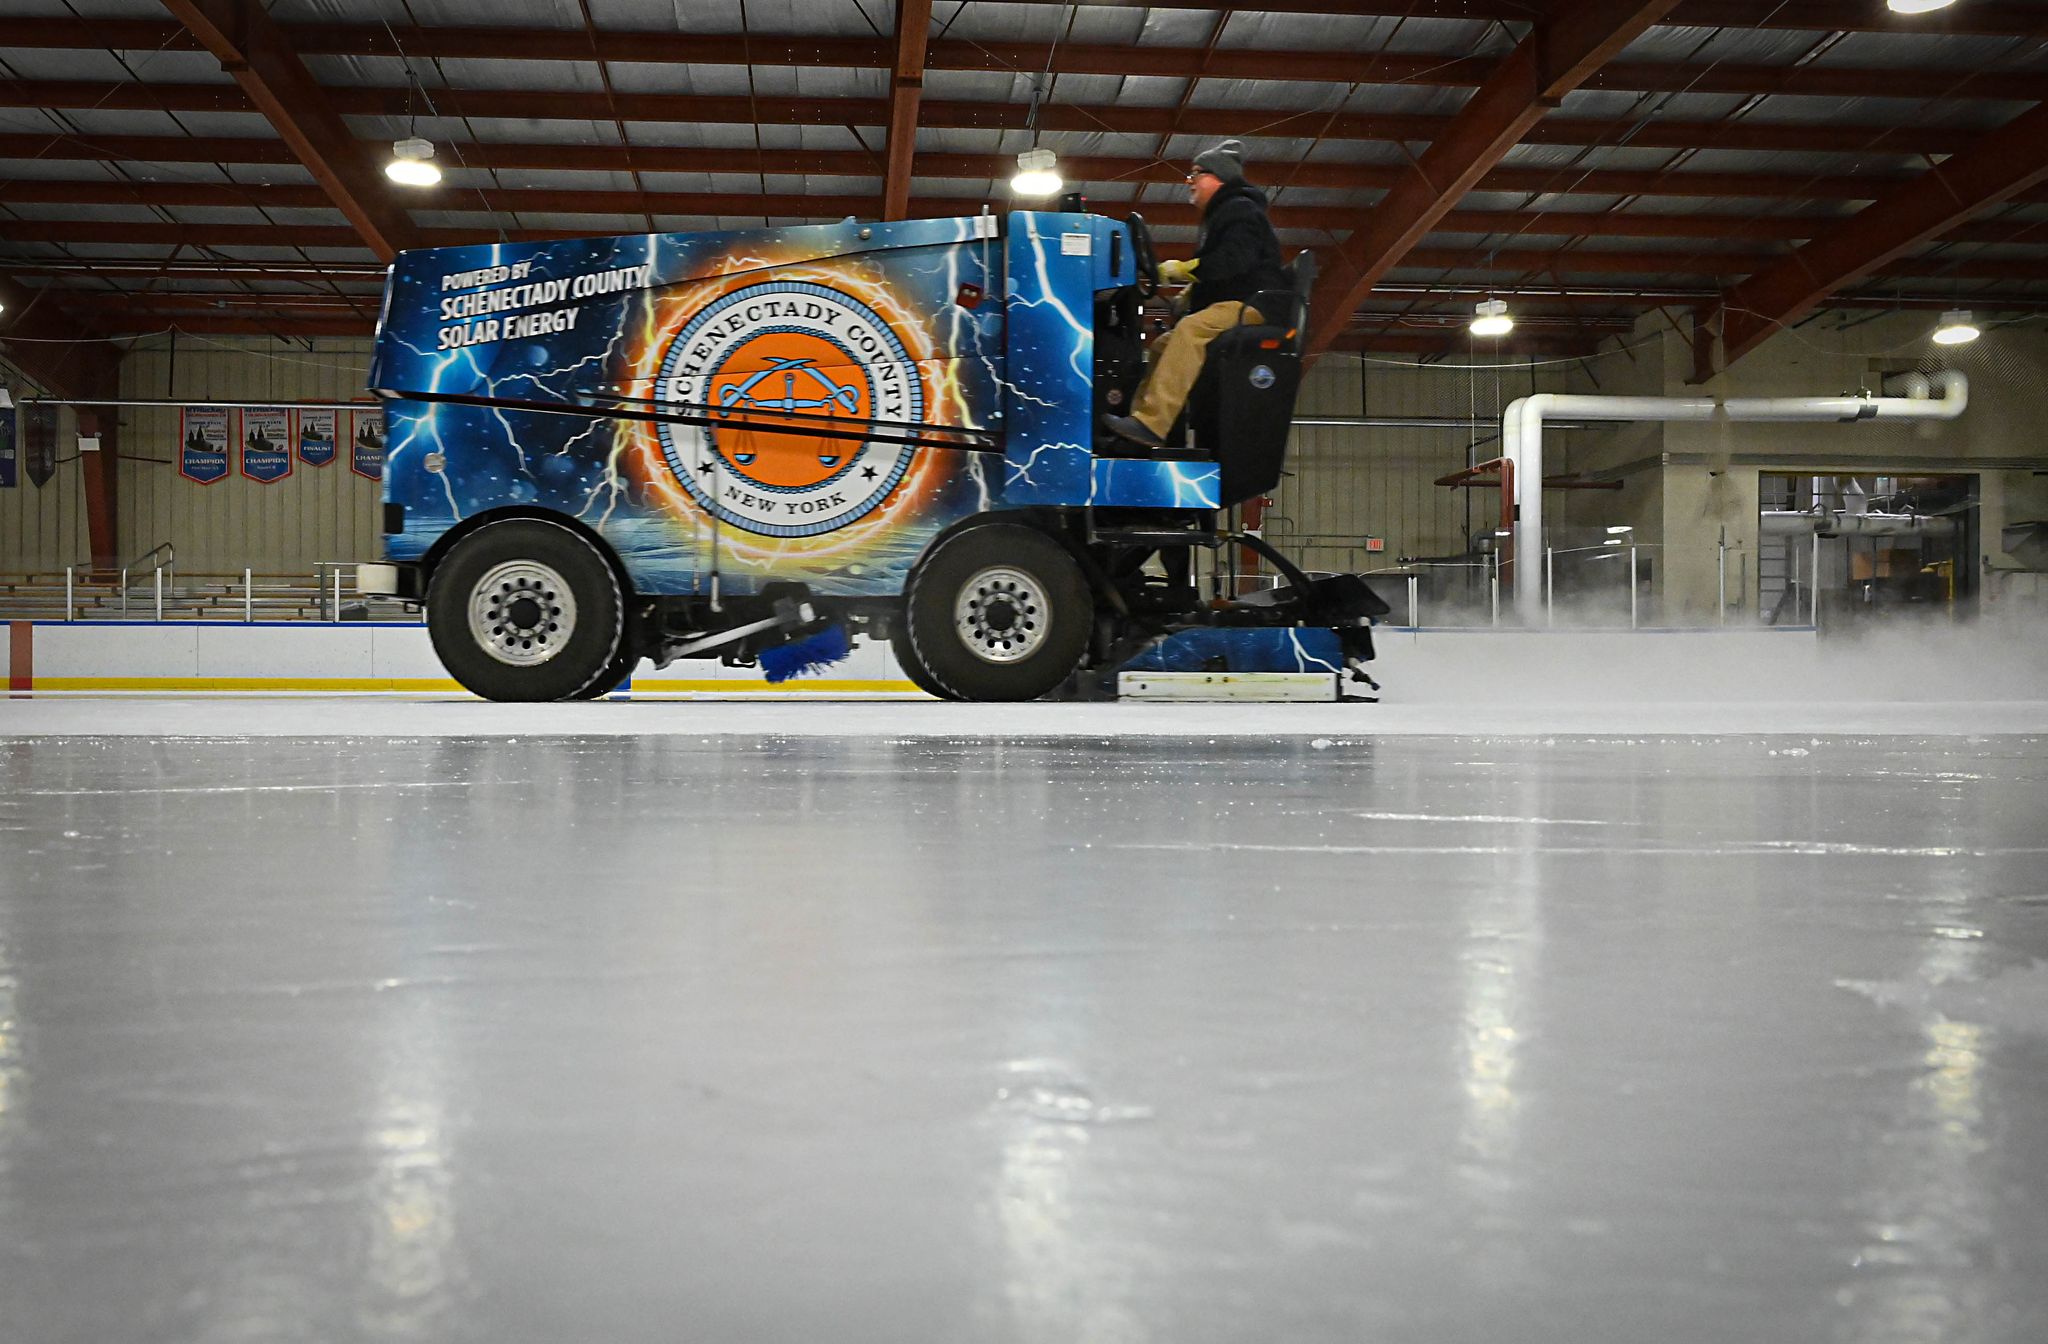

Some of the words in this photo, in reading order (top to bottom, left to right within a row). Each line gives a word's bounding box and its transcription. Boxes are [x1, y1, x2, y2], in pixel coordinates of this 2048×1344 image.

[440, 278, 571, 320] SCHENECTADY
[573, 264, 650, 299] COUNTY
[441, 266, 510, 291] POWERED
[511, 261, 532, 280] BY
[437, 320, 500, 350] SOLAR
[502, 307, 580, 340] ENERGY
[675, 301, 842, 417] SCHENECTADY
[847, 324, 902, 418] COUNTY
[724, 486, 777, 513] NEW
[784, 492, 848, 515] YORK
